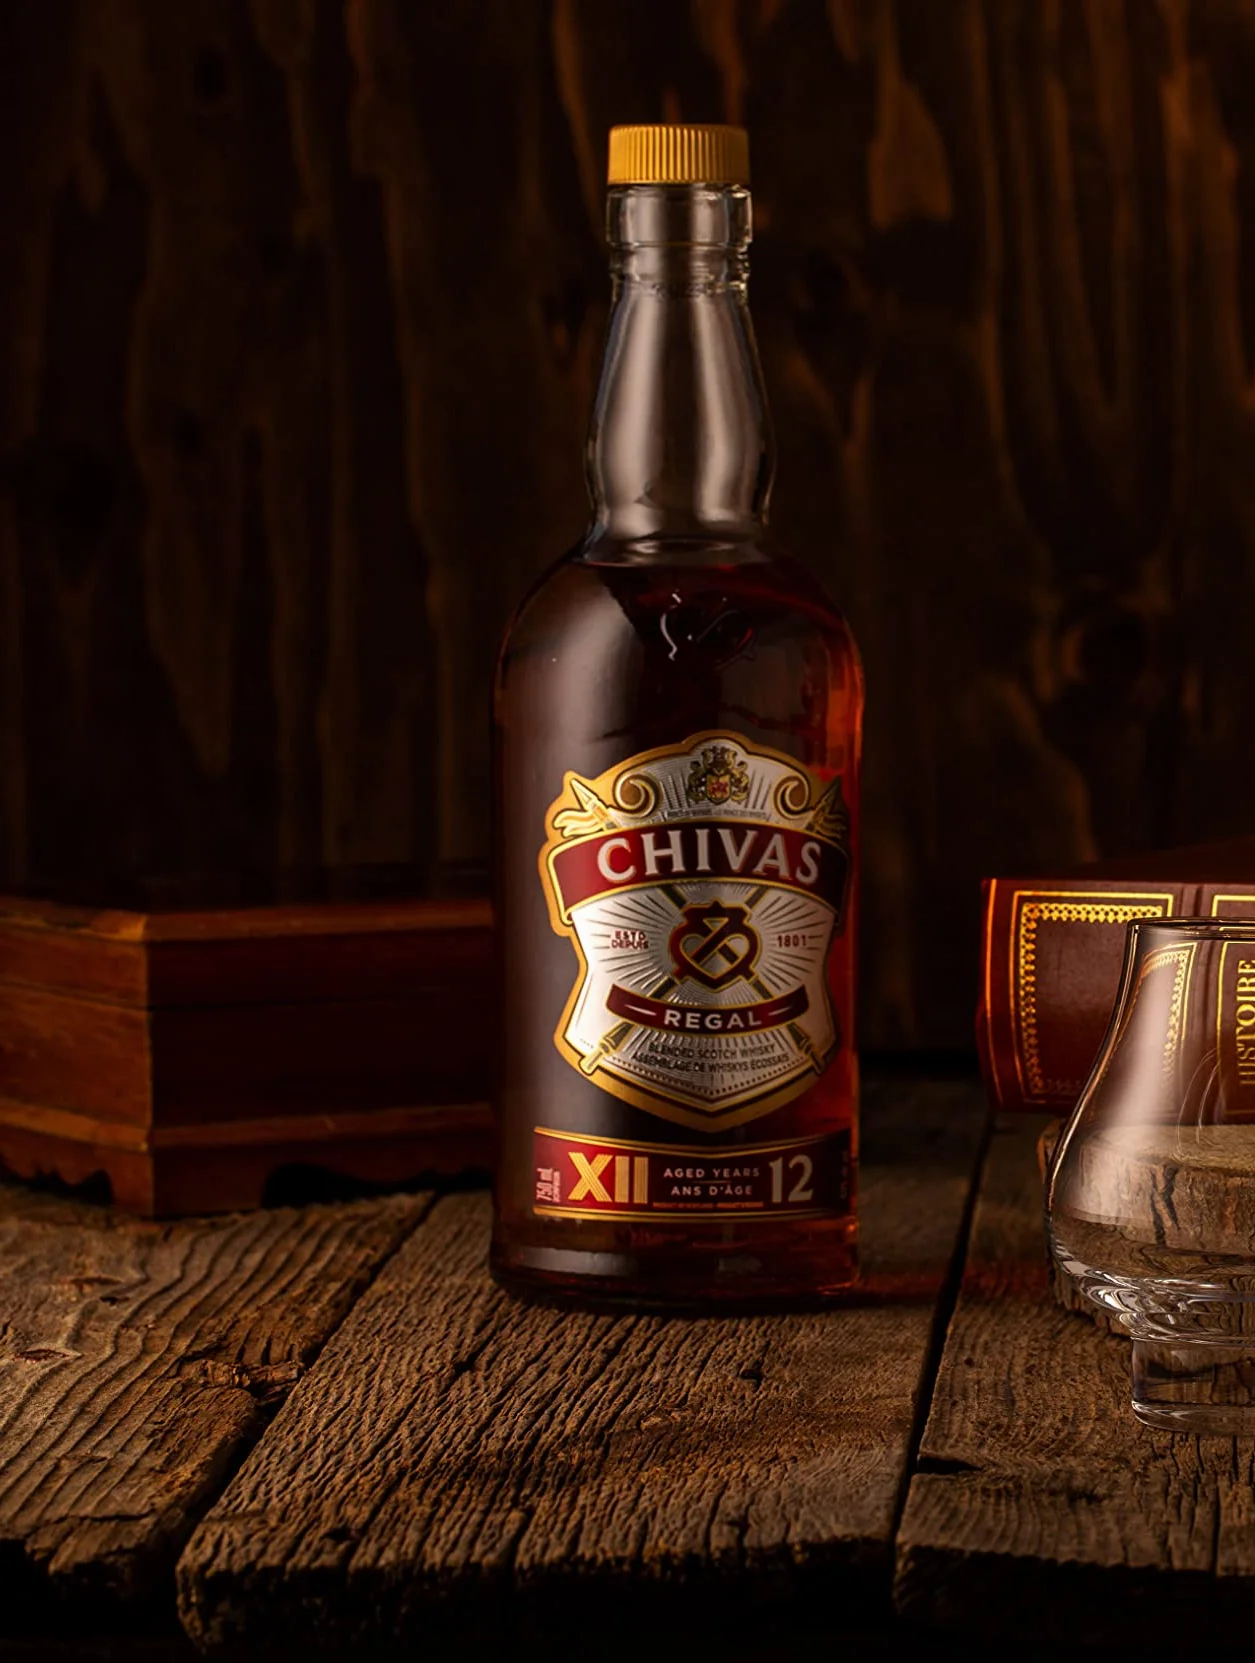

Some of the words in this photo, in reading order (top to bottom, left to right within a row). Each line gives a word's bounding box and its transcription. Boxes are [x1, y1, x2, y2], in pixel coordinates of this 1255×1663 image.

[597, 828, 821, 884] CHIVAS
[615, 931, 646, 940] ESTD
[777, 935, 807, 947] 1801
[611, 940, 649, 949] DEPUIS
[663, 1010, 762, 1030] REGAL
[699, 1049, 736, 1060] SCOTCH
[741, 1044, 775, 1058] WHISKY
[709, 1061, 749, 1073] WHISKYS
[568, 1152, 649, 1204] XII
[663, 1168, 705, 1178] AGED
[713, 1167, 760, 1178] YEARS
[769, 1155, 814, 1204] 12
[671, 1186, 702, 1196] ANS
[709, 1184, 753, 1196] D'ÂGE
